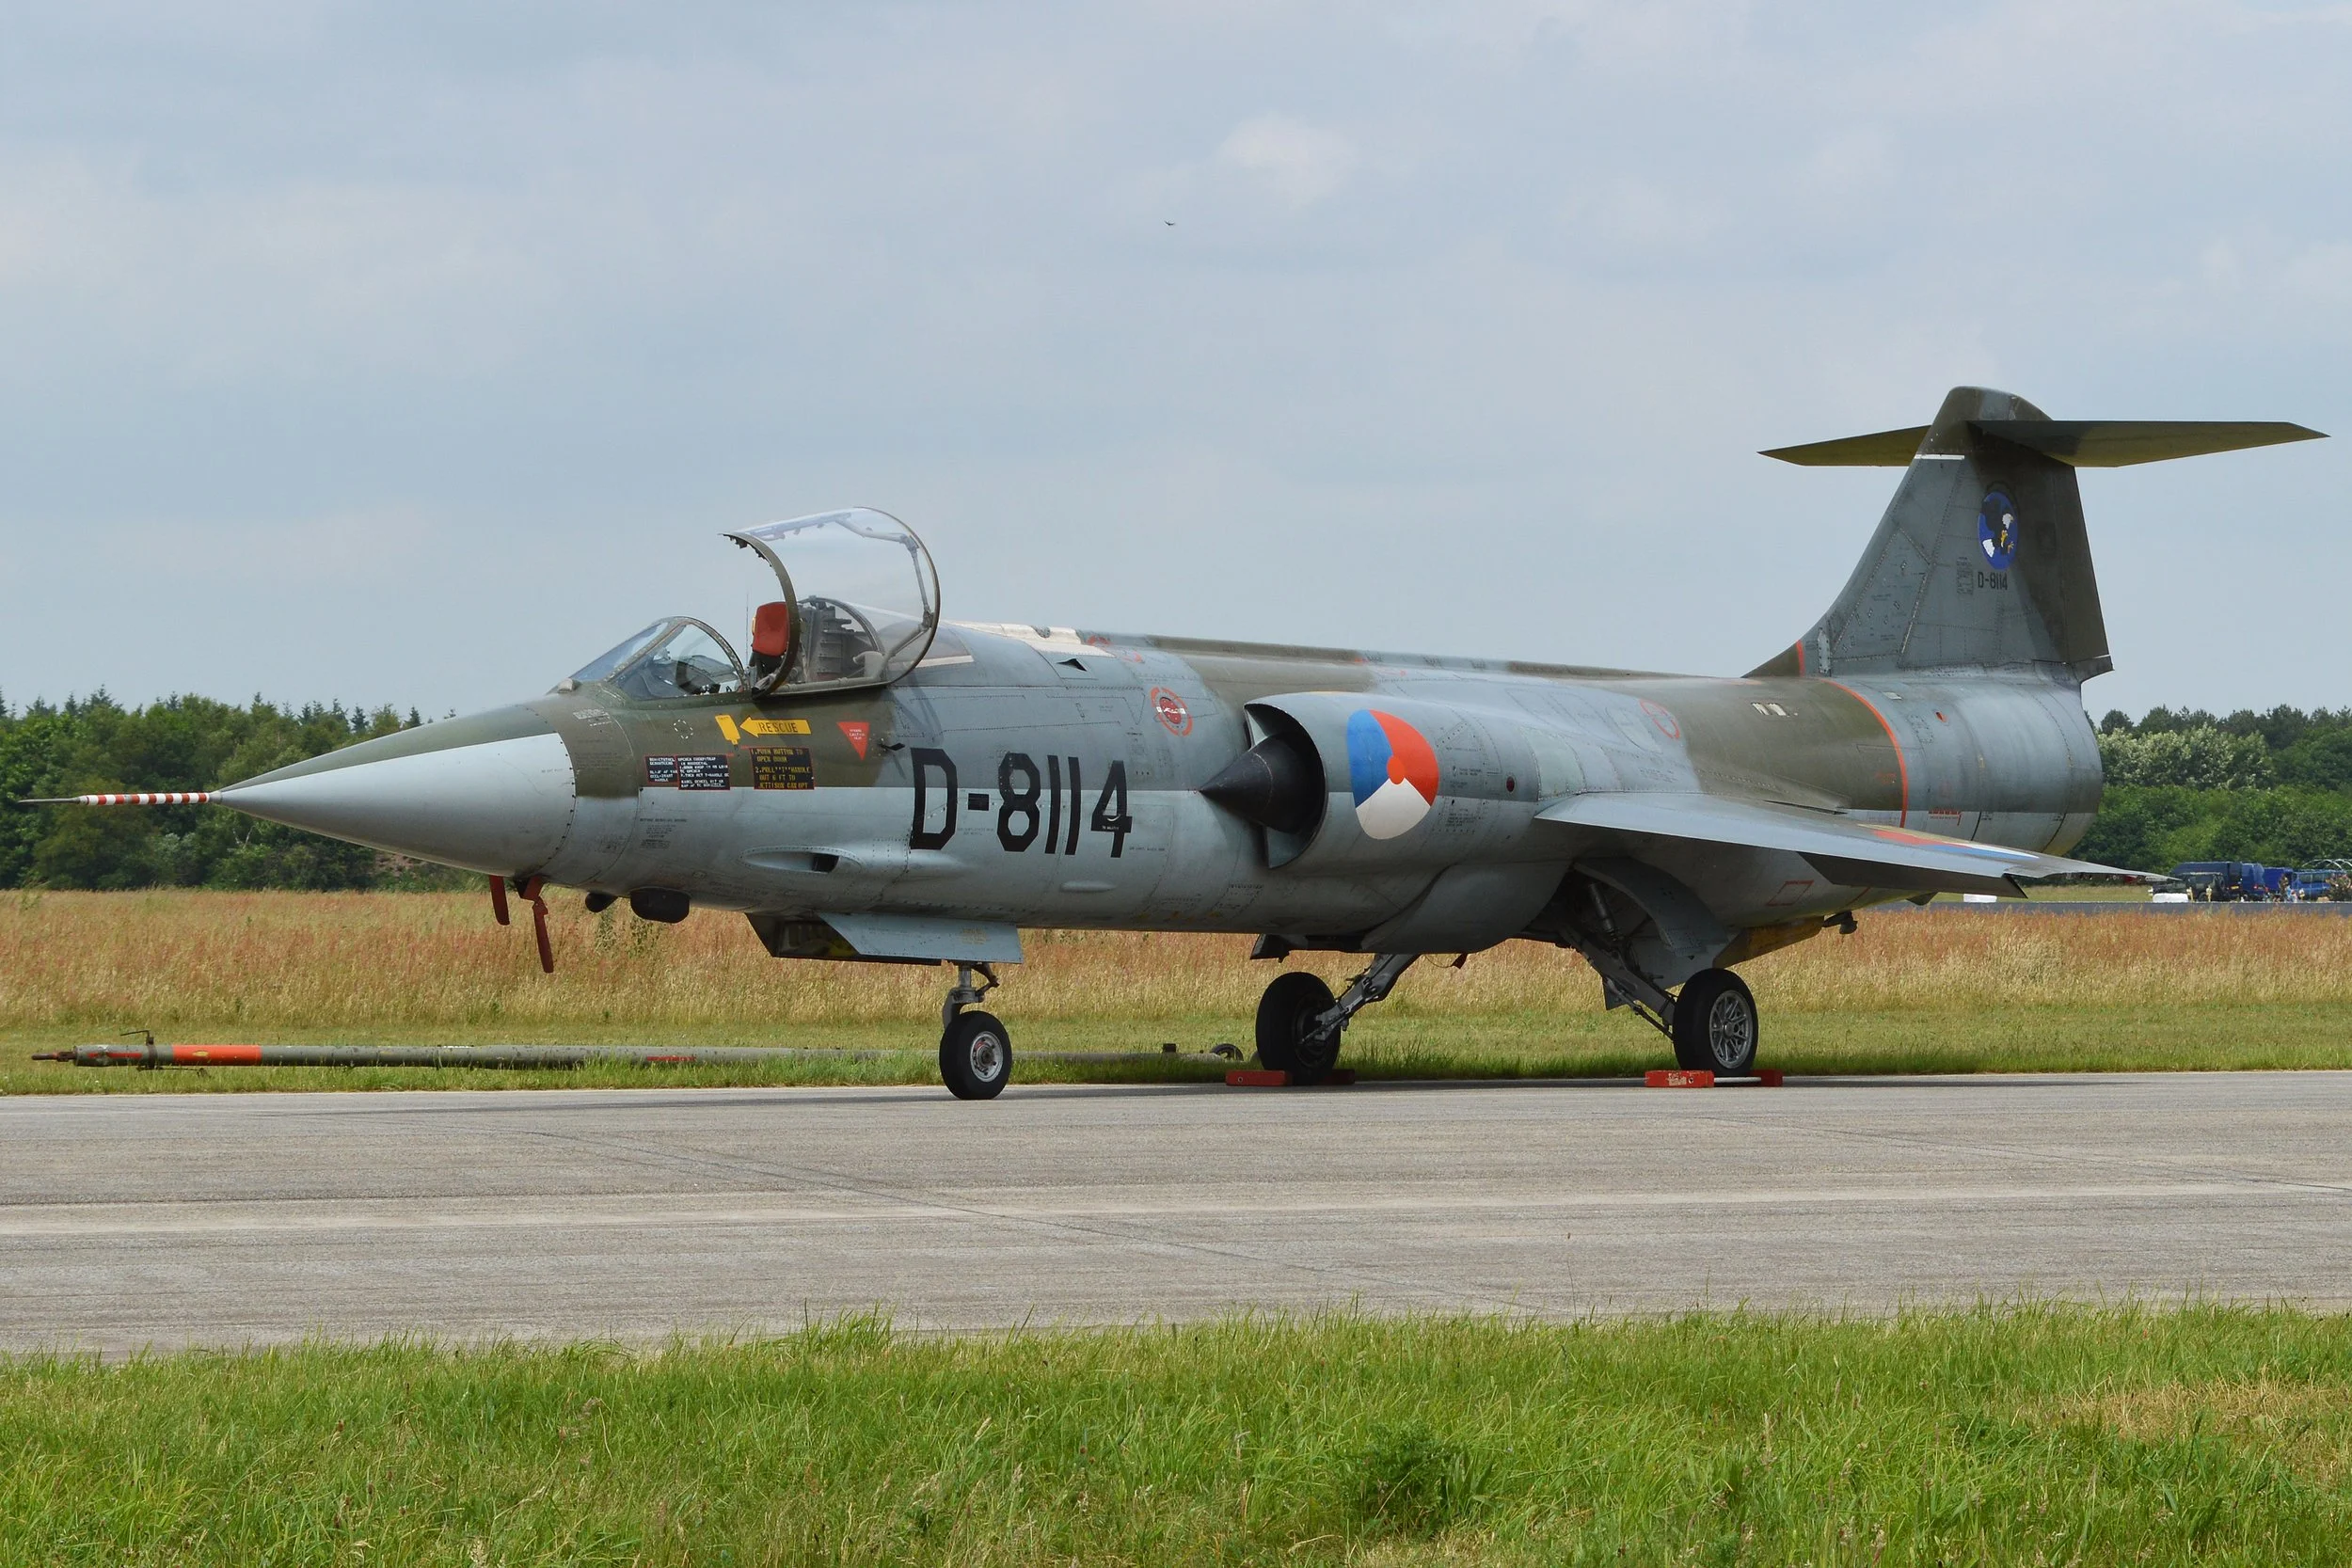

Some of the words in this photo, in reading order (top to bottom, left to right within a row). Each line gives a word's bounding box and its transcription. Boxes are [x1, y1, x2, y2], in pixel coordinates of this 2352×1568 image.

[1978, 571, 2008, 590] D-8114
[757, 721, 799, 733] RESCUE
[909, 747, 1133, 858] D-8114
